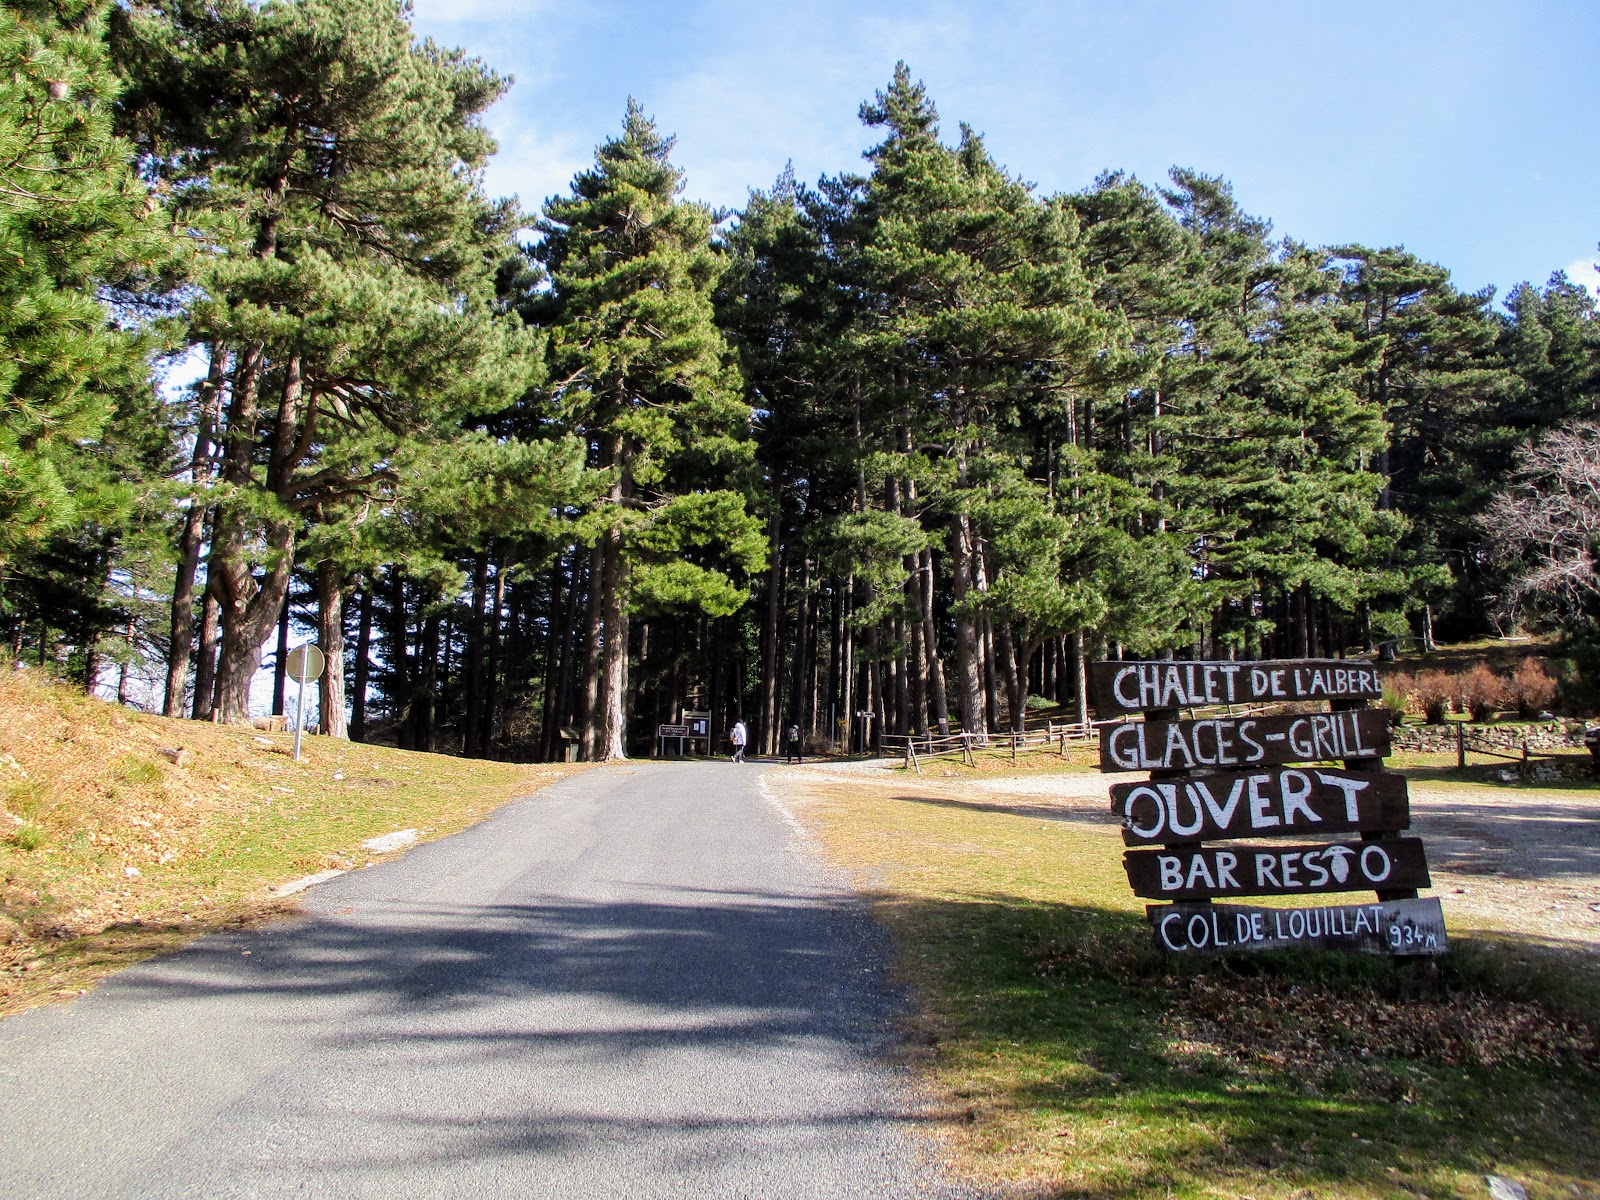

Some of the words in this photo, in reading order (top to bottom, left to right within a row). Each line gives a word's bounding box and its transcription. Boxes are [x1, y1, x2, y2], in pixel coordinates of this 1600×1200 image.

[1112, 664, 1241, 708] CHALET
[1251, 668, 1286, 697] DE
[1124, 769, 1370, 839] OUVERT
[1157, 851, 1242, 891] BAR
[1254, 845, 1391, 888] RESTO
